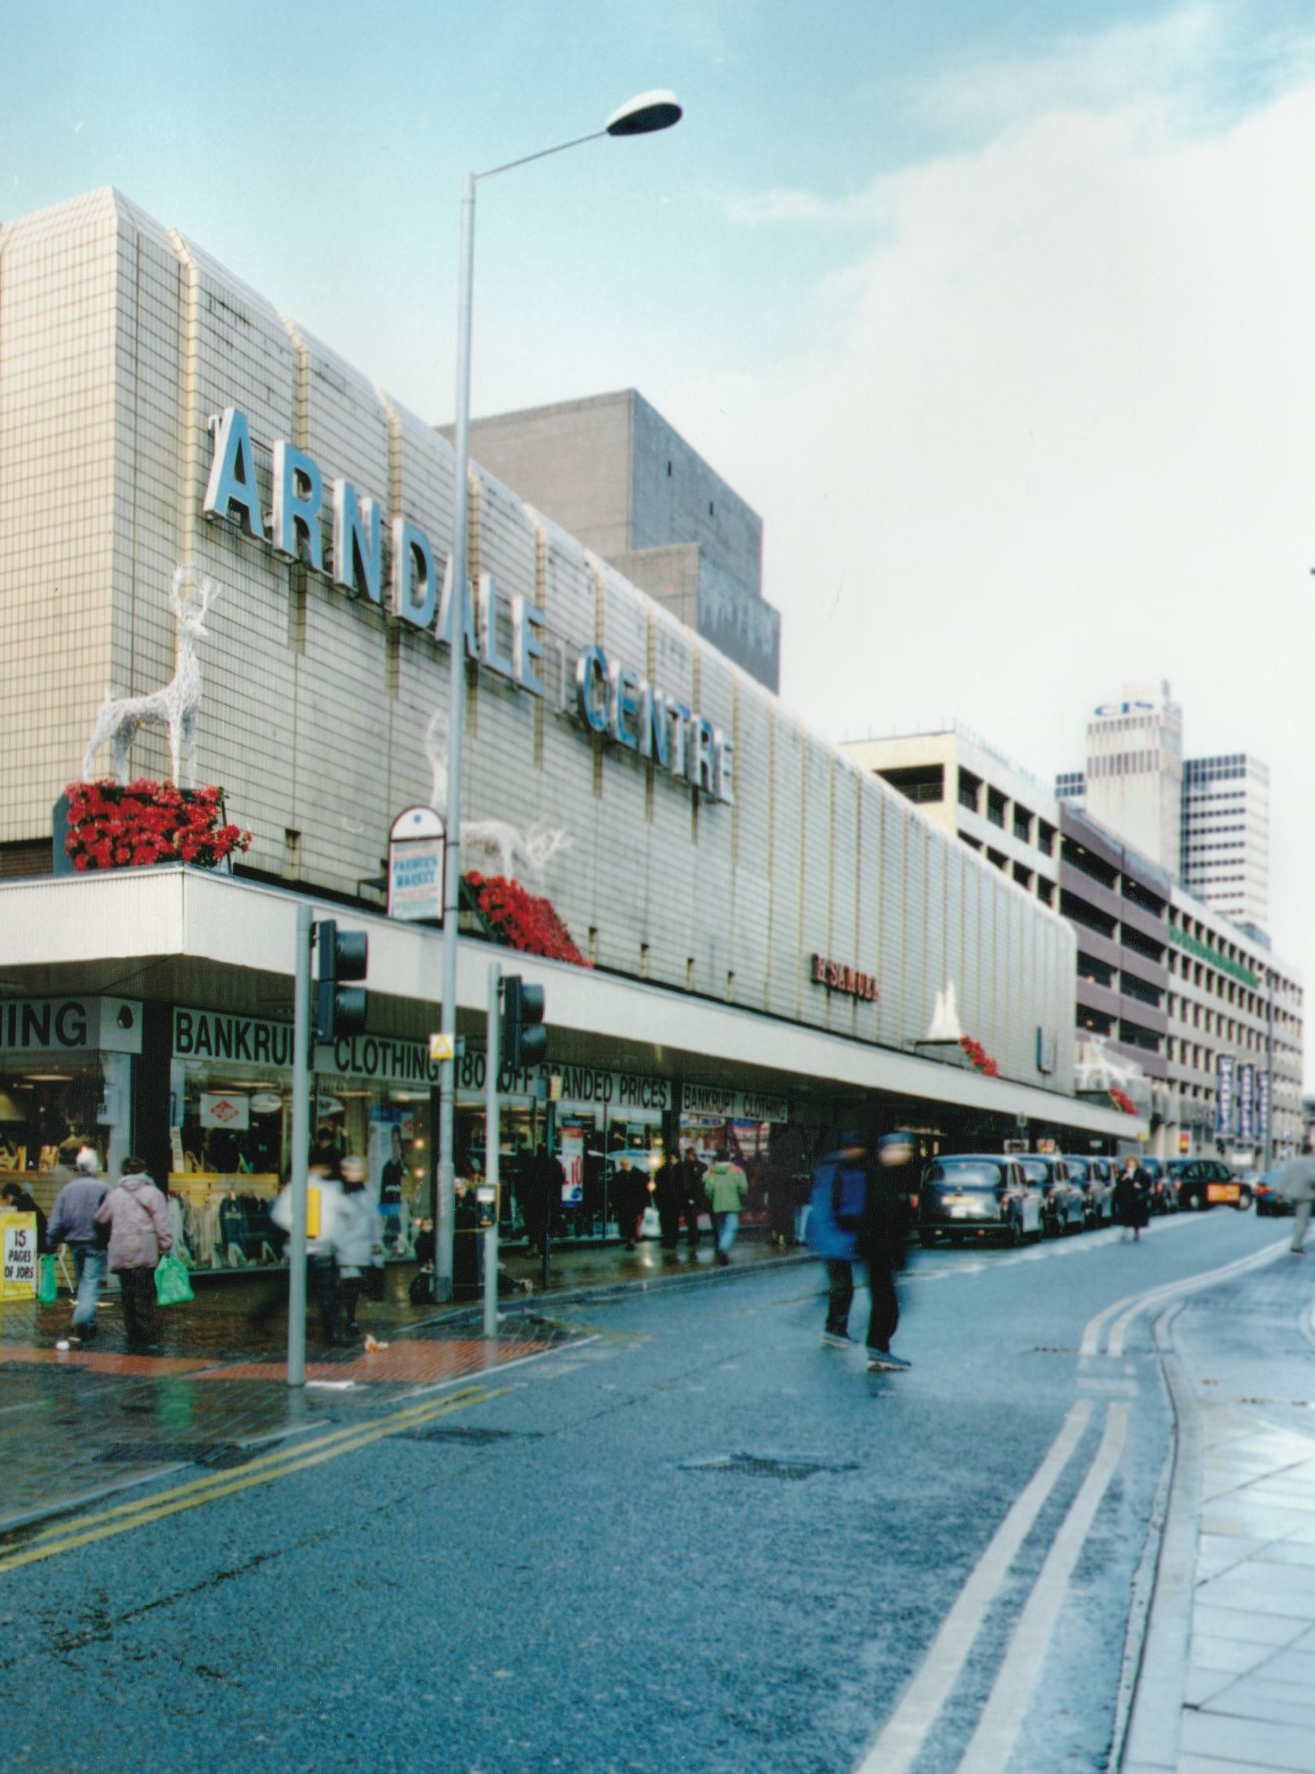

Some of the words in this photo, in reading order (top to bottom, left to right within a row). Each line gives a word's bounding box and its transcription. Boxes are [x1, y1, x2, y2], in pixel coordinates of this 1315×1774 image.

[203, 406, 547, 697] ARNDALE
[576, 644, 735, 804] CENTRE
[1093, 700, 1155, 717] CIS
[176, 1011, 315, 1071] BANKRU
[334, 1035, 439, 1082] CLOTHING
[619, 1077, 668, 1110] PRICES
[684, 1085, 736, 1114] BANKRUPT
[14, 1230, 27, 1247] 15
[8, 1250, 32, 1263] PAGES
[4, 1266, 15, 1279] OF
[16, 1266, 34, 1279] JOBS
